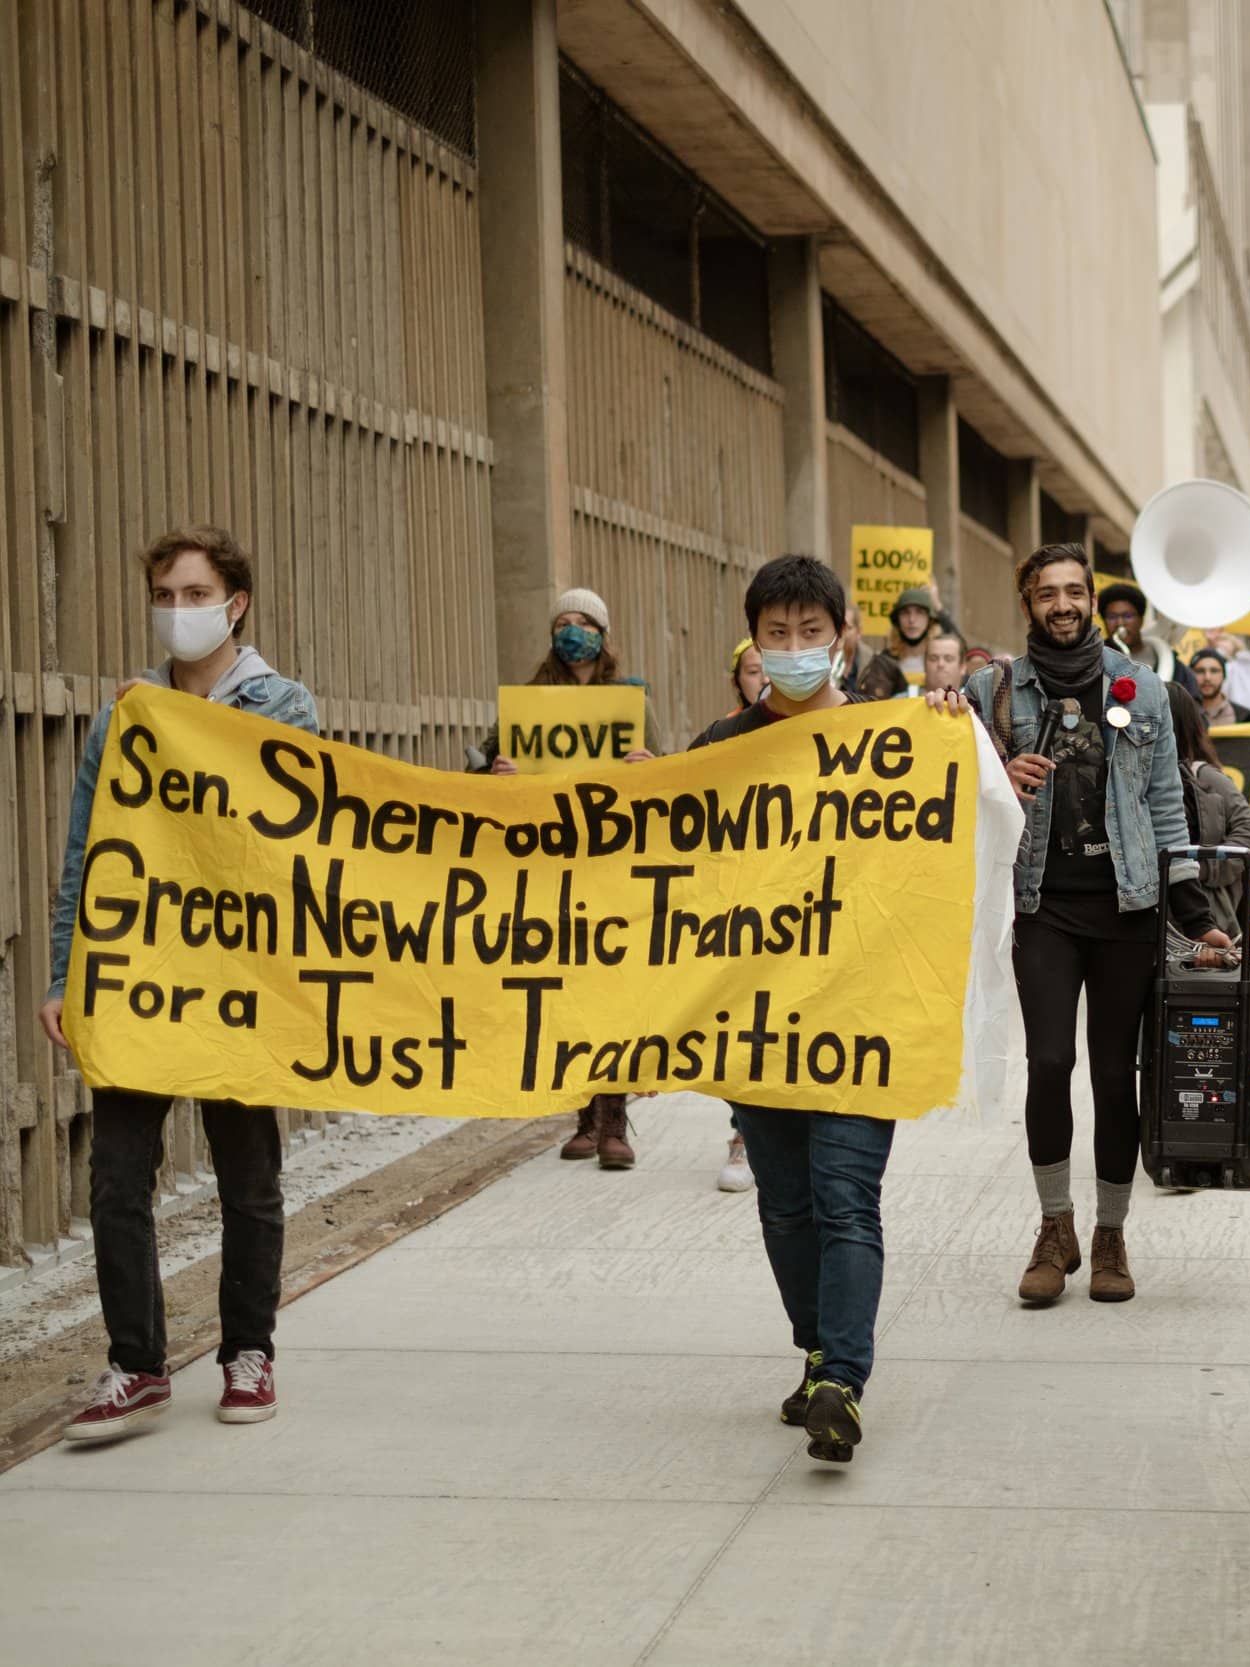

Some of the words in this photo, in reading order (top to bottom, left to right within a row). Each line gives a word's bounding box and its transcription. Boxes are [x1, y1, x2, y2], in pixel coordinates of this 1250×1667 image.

[857, 548, 928, 571] 100%
[509, 722, 635, 760] MOVE
[813, 726, 914, 780] we
[110, 724, 238, 818] Sen.
[247, 739, 578, 859] Sherrod
[576, 782, 802, 857] Brown,
[807, 762, 958, 844] need
[1084, 842, 1110, 856] Bern
[78, 838, 278, 955] Green
[292, 854, 439, 962] New
[443, 867, 629, 966] Public
[631, 855, 842, 966] Transit
[83, 951, 205, 1023] For
[218, 989, 258, 1030] a
[291, 969, 468, 1090] Just
[502, 976, 891, 1091] Transition
